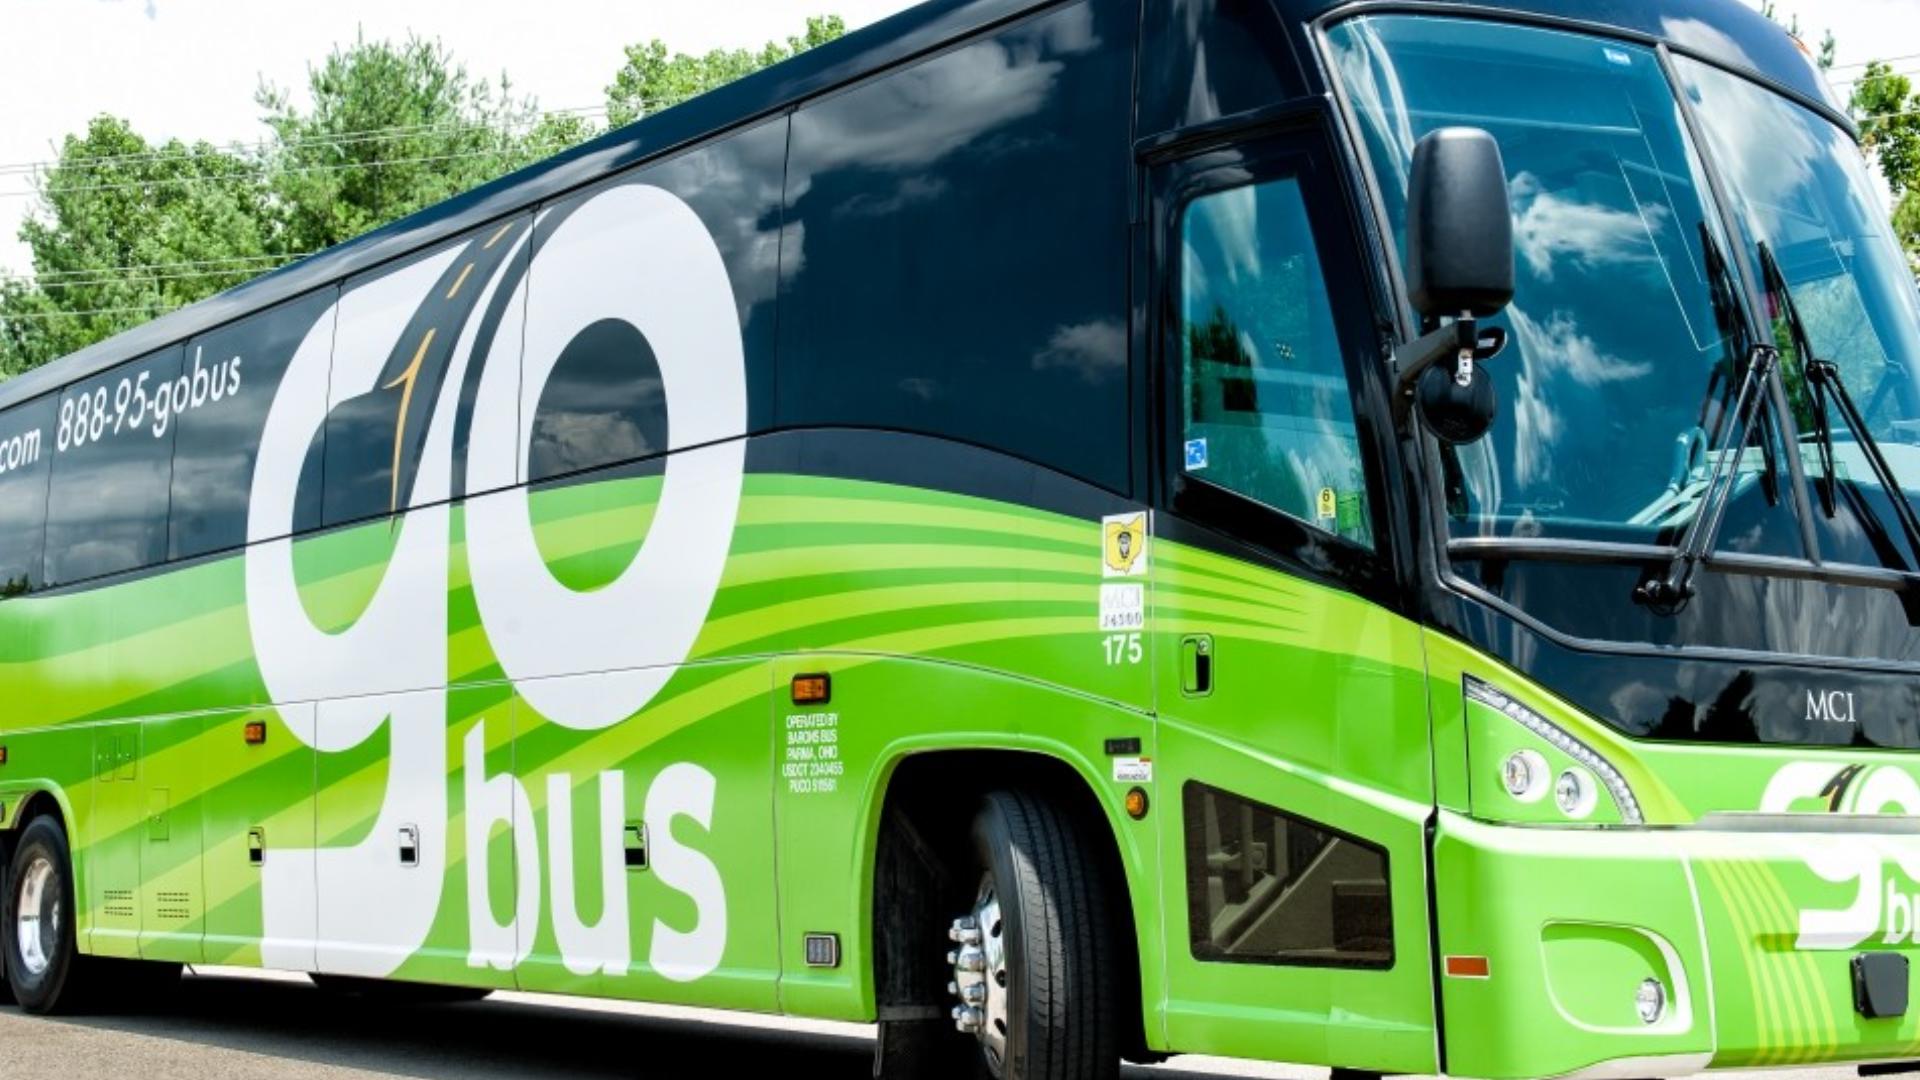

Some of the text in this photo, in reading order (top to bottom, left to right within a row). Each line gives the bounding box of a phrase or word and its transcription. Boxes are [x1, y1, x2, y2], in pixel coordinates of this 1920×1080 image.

[57, 346, 241, 452] 888-95-gobus
[1102, 633, 1142, 665] 175
[786, 712, 838, 729] OPERATED BY
[1805, 689, 1856, 722] MCI
[787, 729, 837, 745] BARONS BUS
[818, 745, 837, 759] OHIO
[464, 718, 727, 982] bus
